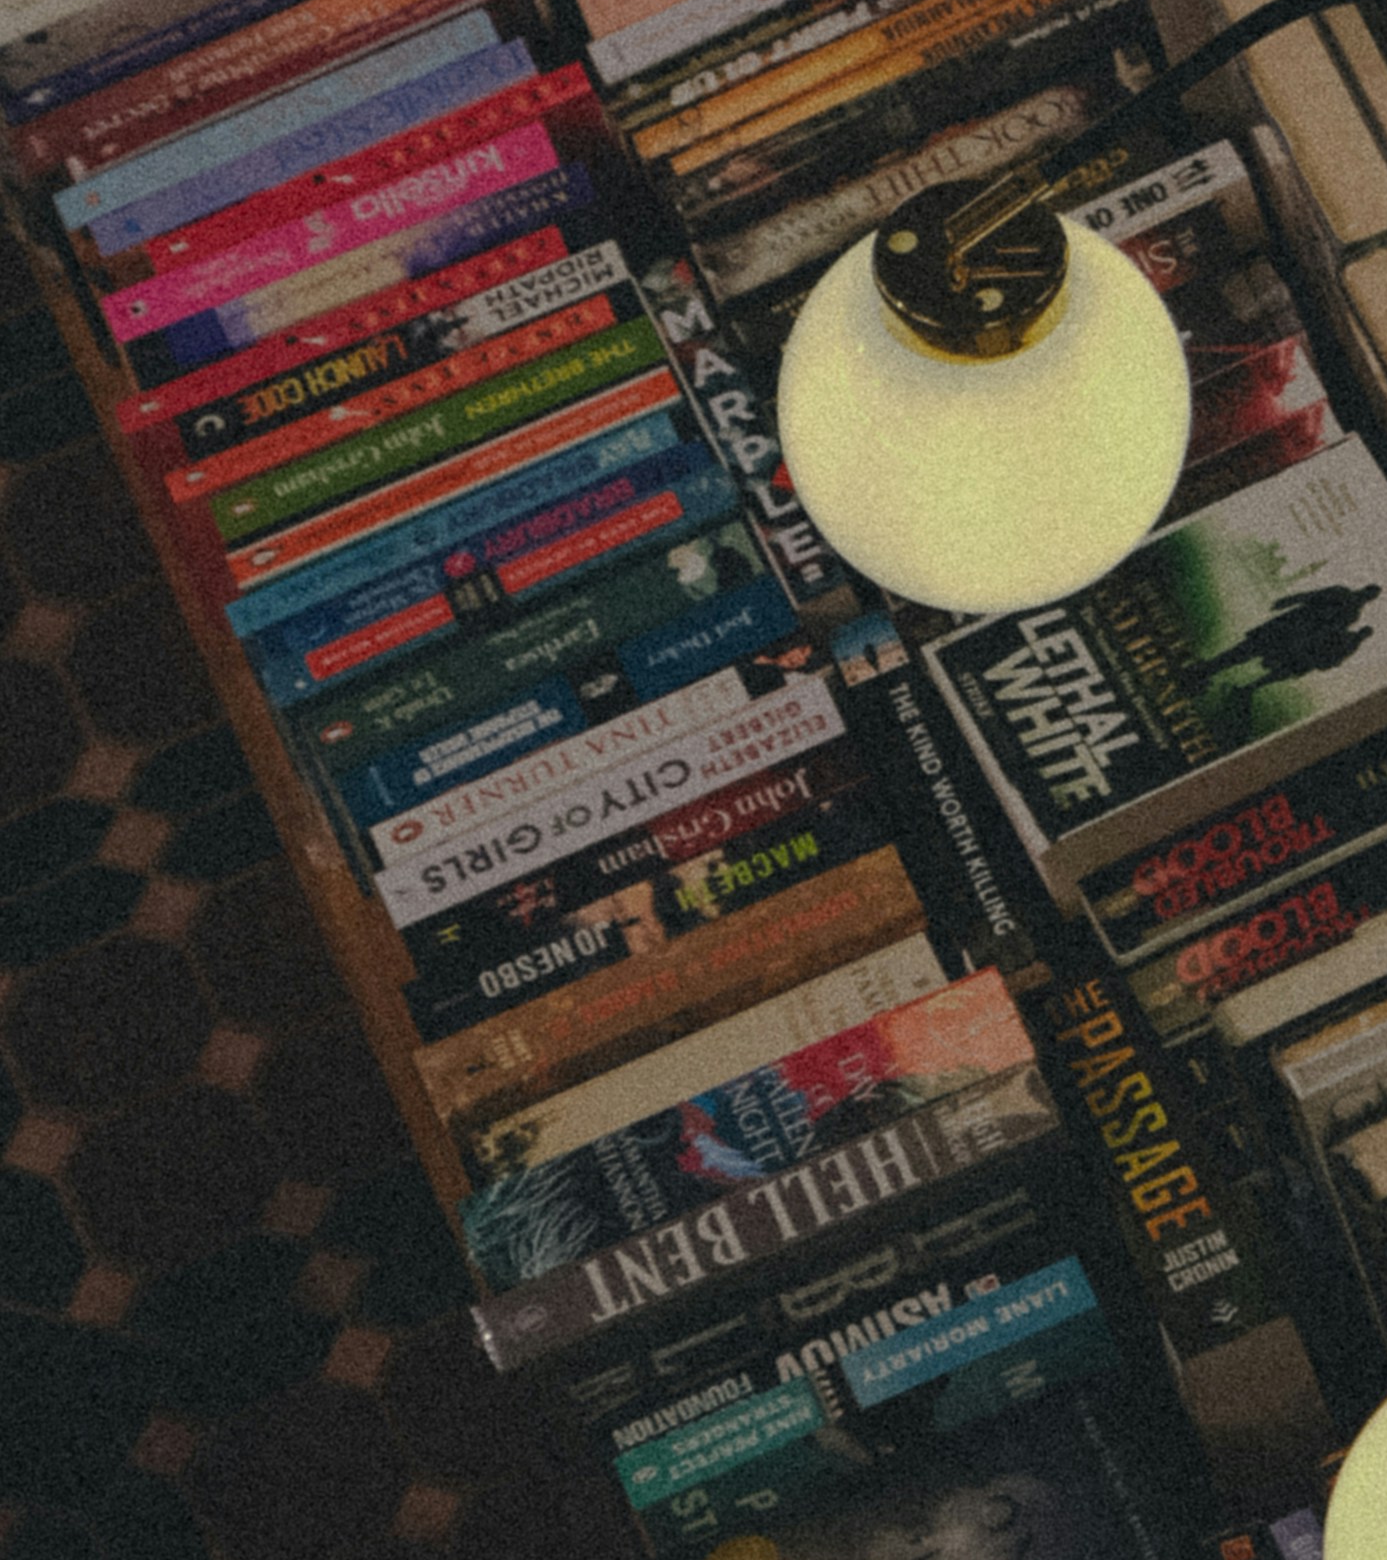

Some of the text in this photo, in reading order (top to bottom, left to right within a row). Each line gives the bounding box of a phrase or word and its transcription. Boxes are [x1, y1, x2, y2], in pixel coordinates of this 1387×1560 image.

[348, 141, 504, 226] kinsella
[1117, 178, 1168, 215] ONE
[482, 246, 604, 309] RIDPATH
[486, 261, 616, 326] MICHAEL
[303, 332, 408, 397] LAUNCH
[461, 356, 585, 420] BRETHREN
[586, 335, 635, 369] THE
[235, 375, 307, 425] CODE
[657, 294, 827, 568] MARPLE
[271, 409, 450, 502] John Grisham
[478, 474, 636, 561] BRADBURY
[500, 615, 601, 676] Earthsea
[703, 697, 802, 753] GILBERT
[1017, 605, 1145, 770] LETHAL
[584, 705, 673, 760] TINA
[696, 710, 827, 780] ELIZABETH
[977, 647, 1111, 812] WHITE
[416, 754, 692, 896] CITY OF GIRLS
[431, 748, 575, 827] TURNER
[593, 764, 815, 880] John Grisham
[886, 680, 1016, 939] THE KIND WORTH KILLING
[672, 830, 819, 913] MACBETH
[1125, 790, 1295, 898] BLOOD
[1147, 808, 1335, 922] TROUBLED
[474, 918, 616, 999] JO NESBO
[1169, 876, 1342, 988] BLOOD
[756, 1062, 821, 1160] FALLEN
[837, 1052, 880, 1108] DAY
[724, 1077, 786, 1171] NIGHT
[1054, 1007, 1213, 1241] PASSAGE
[572, 1125, 919, 1325] HELL BENT
[1157, 1227, 1230, 1273] JUSTIN
[1167, 1247, 1241, 1292] CRONIN
[857, 1278, 1068, 1384] LIANE MORIARTY
[609, 1369, 754, 1451] FOUNDATION
[664, 1405, 812, 1481] NINE PERFECT
[667, 1393, 793, 1458] STRANGERS
